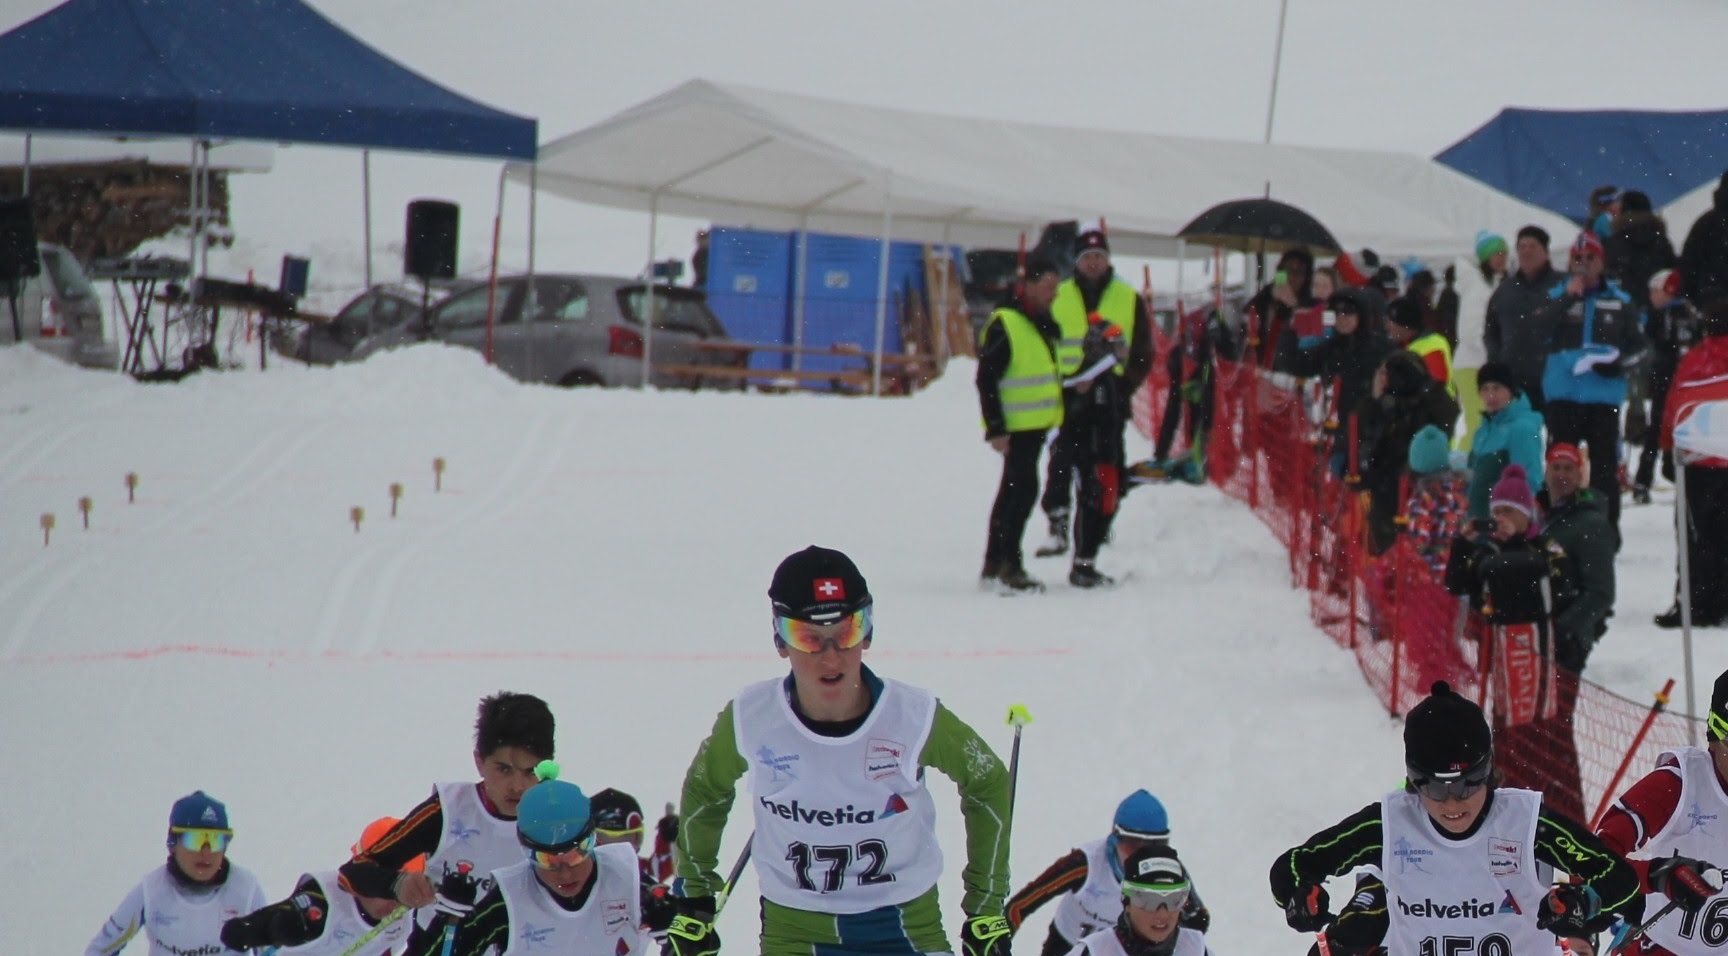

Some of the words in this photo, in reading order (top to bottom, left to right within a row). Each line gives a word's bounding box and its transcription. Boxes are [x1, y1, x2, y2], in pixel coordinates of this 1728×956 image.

[760, 795, 875, 827] helvetia
[784, 838, 897, 894] 172
[1397, 895, 1494, 919] helvetia
